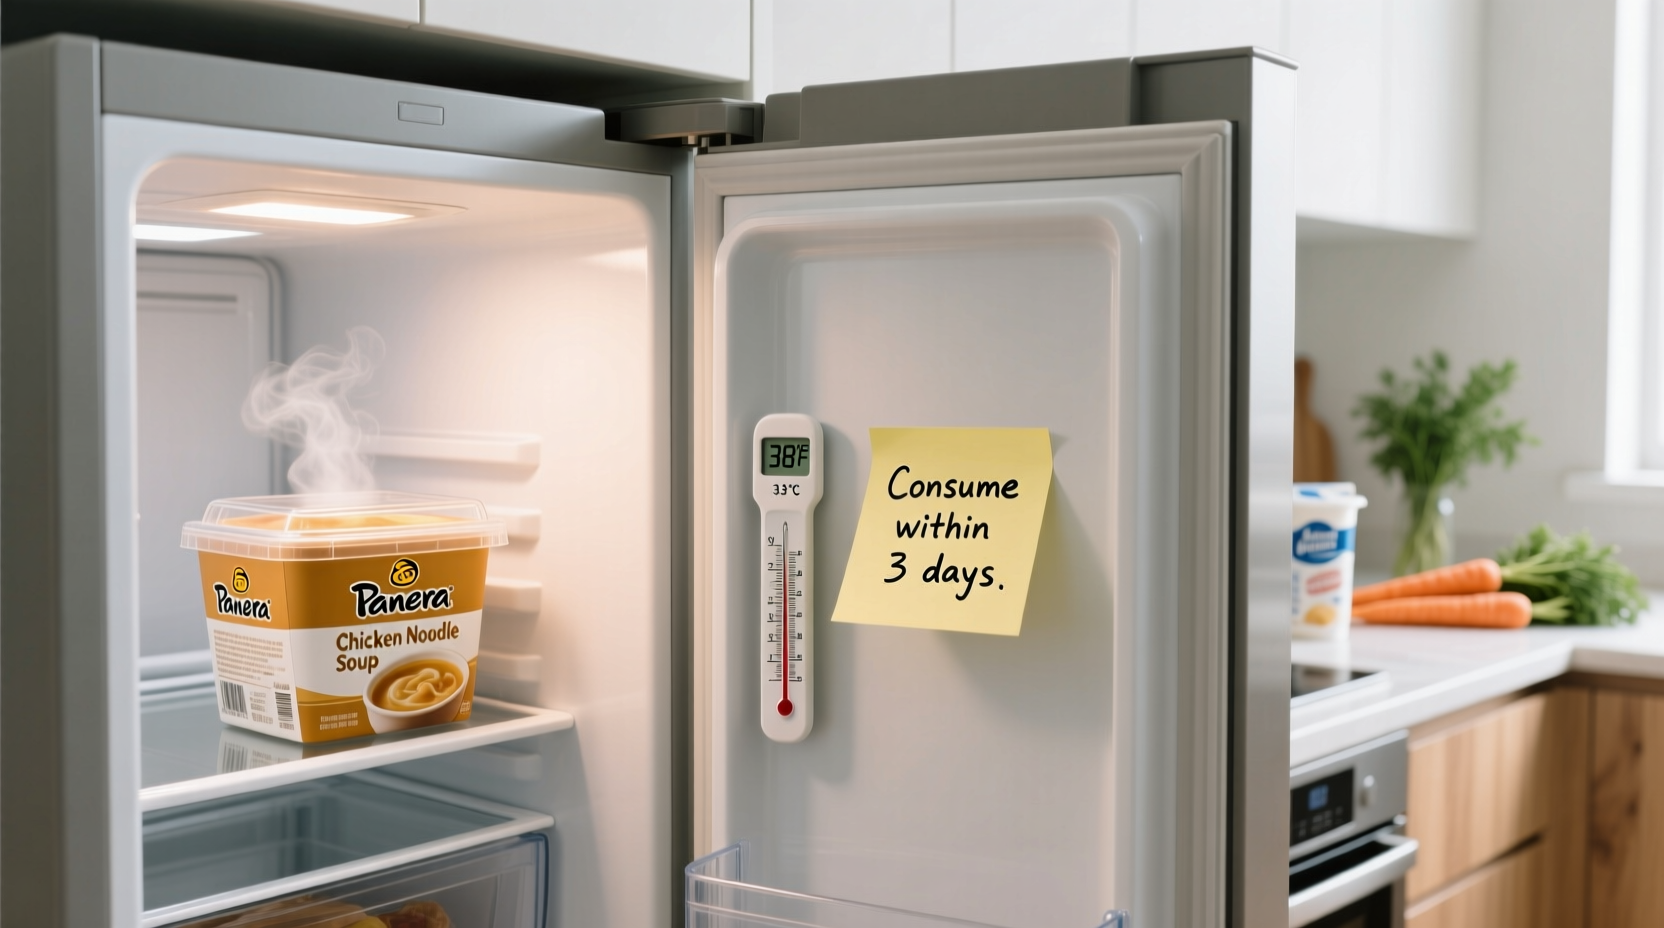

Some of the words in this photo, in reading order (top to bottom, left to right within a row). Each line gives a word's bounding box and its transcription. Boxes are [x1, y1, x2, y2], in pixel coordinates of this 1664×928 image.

[887, 465, 1019, 500] Consume
[896, 511, 989, 539] within
[883, 552, 907, 583] 3
[922, 553, 1004, 601] days.
[214, 583, 271, 620] Panera
[351, 582, 452, 618] Panera
[336, 629, 402, 652] Chicken
[406, 621, 459, 645] Noodle
[336, 654, 379, 674] Soup
